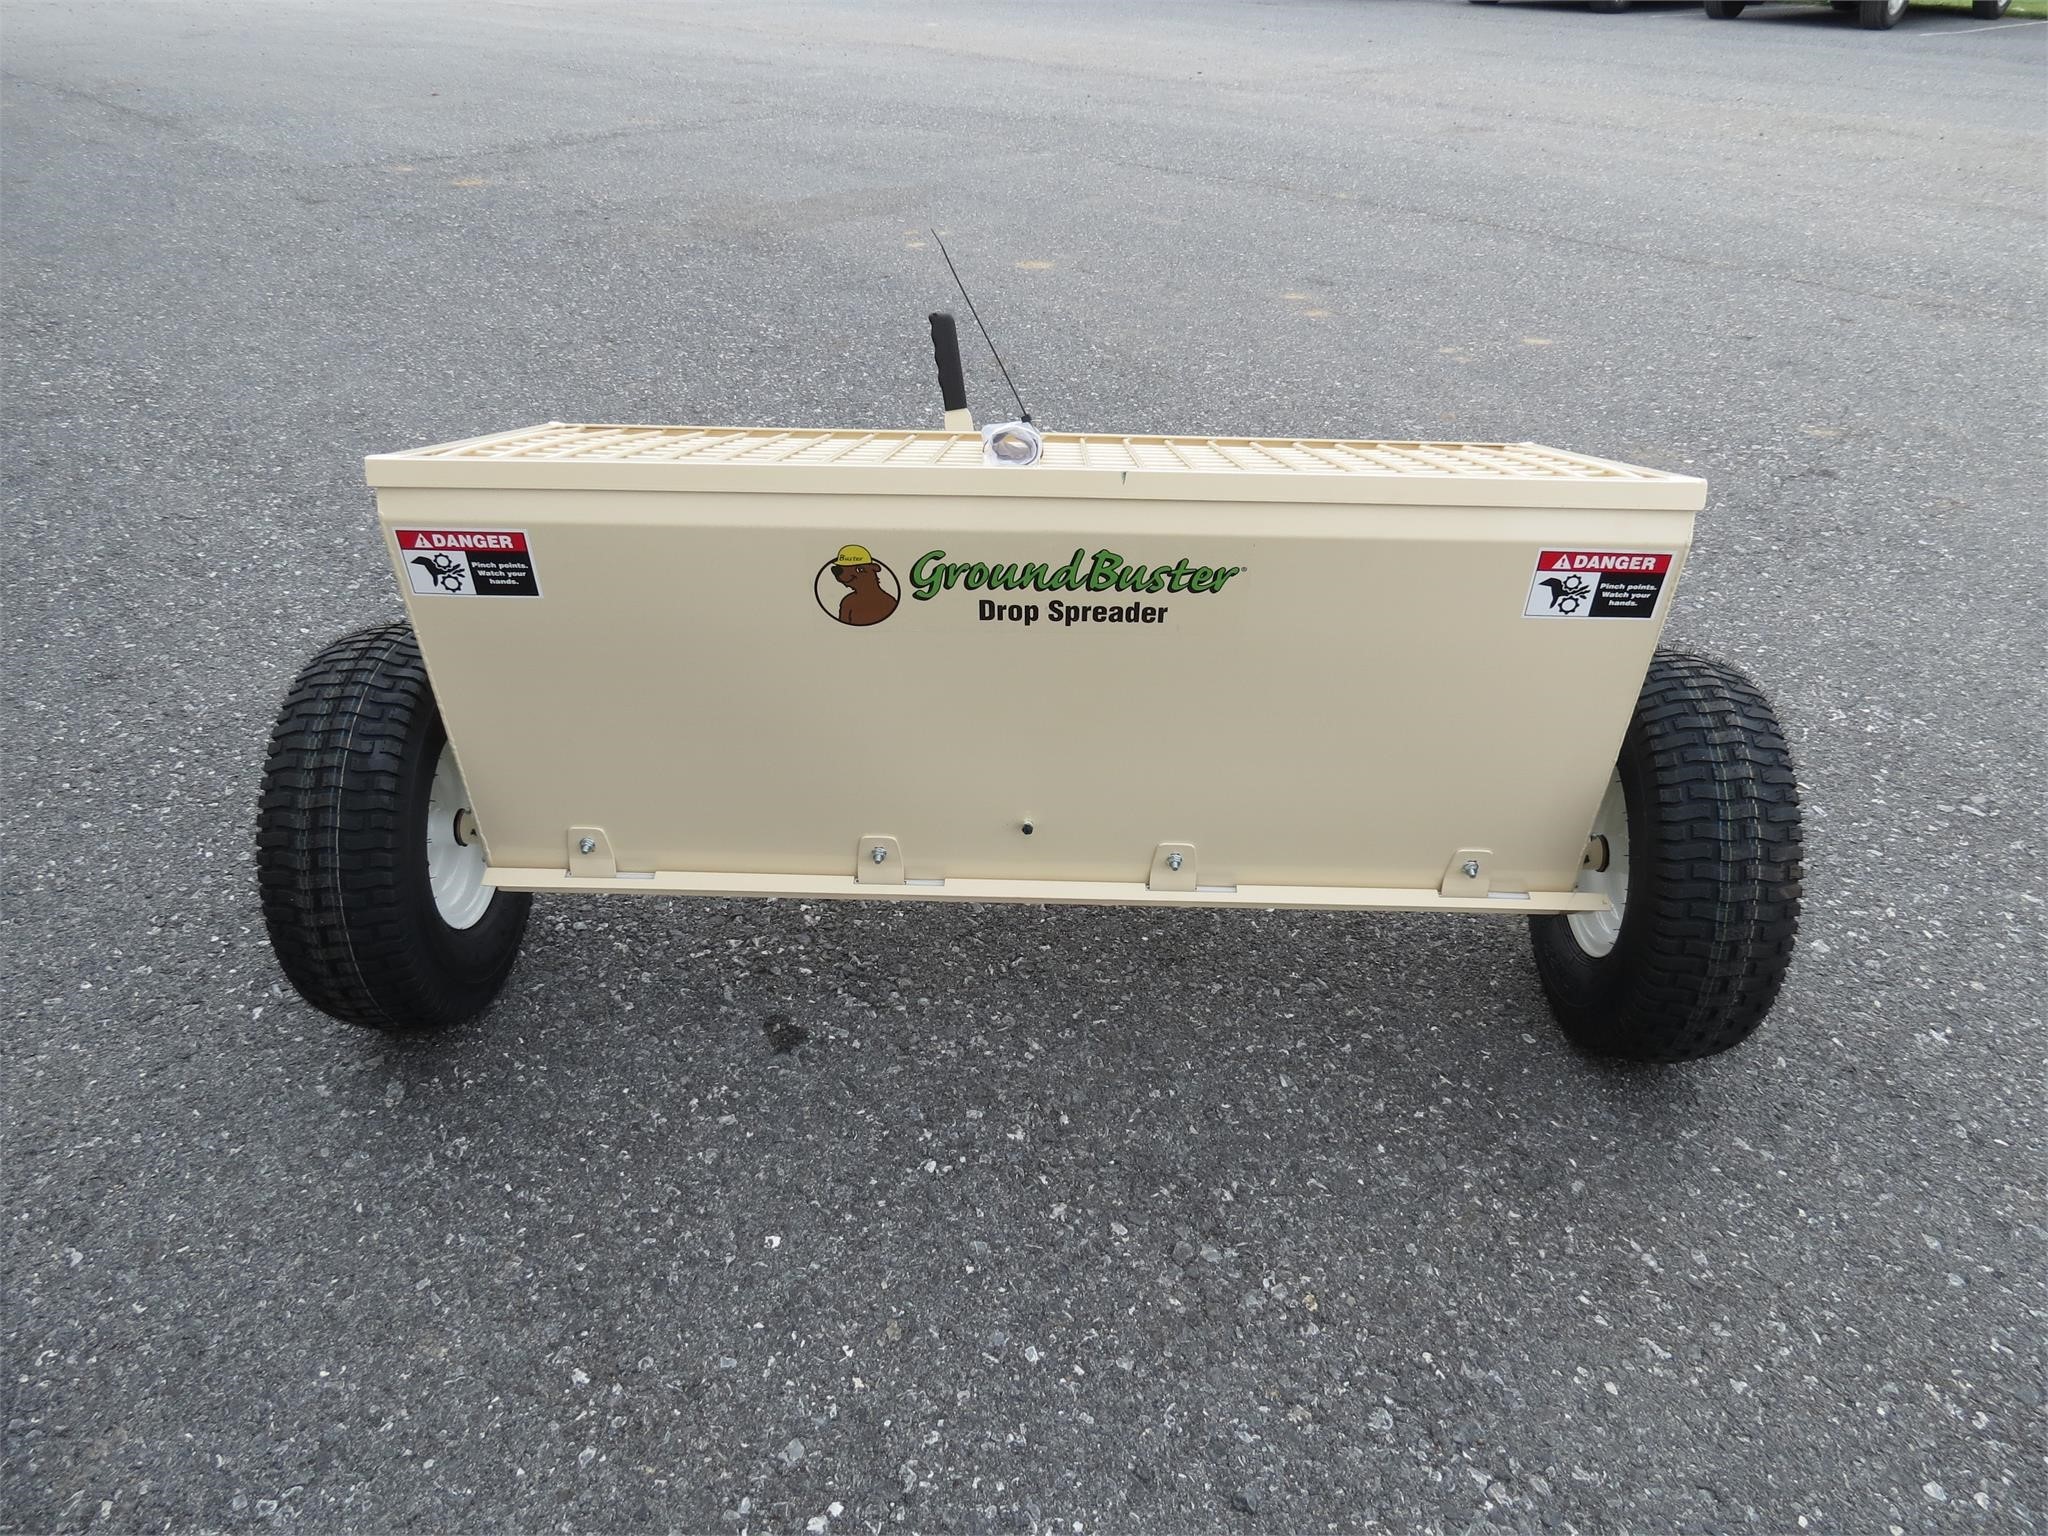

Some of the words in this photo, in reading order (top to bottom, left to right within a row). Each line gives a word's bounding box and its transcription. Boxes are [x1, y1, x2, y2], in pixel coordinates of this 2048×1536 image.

[432, 534, 513, 549] DANGER
[471, 561, 497, 569] Pinch
[499, 562, 529, 570] points.
[1573, 555, 1656, 570] DANGER
[909, 548, 1240, 601] GroundBuster
[1627, 583, 1657, 591] points.
[1631, 592, 1651, 600] your
[1608, 599, 1638, 607] hands.
[979, 599, 1039, 626] Drop
[1048, 600, 1168, 626] Spreader
